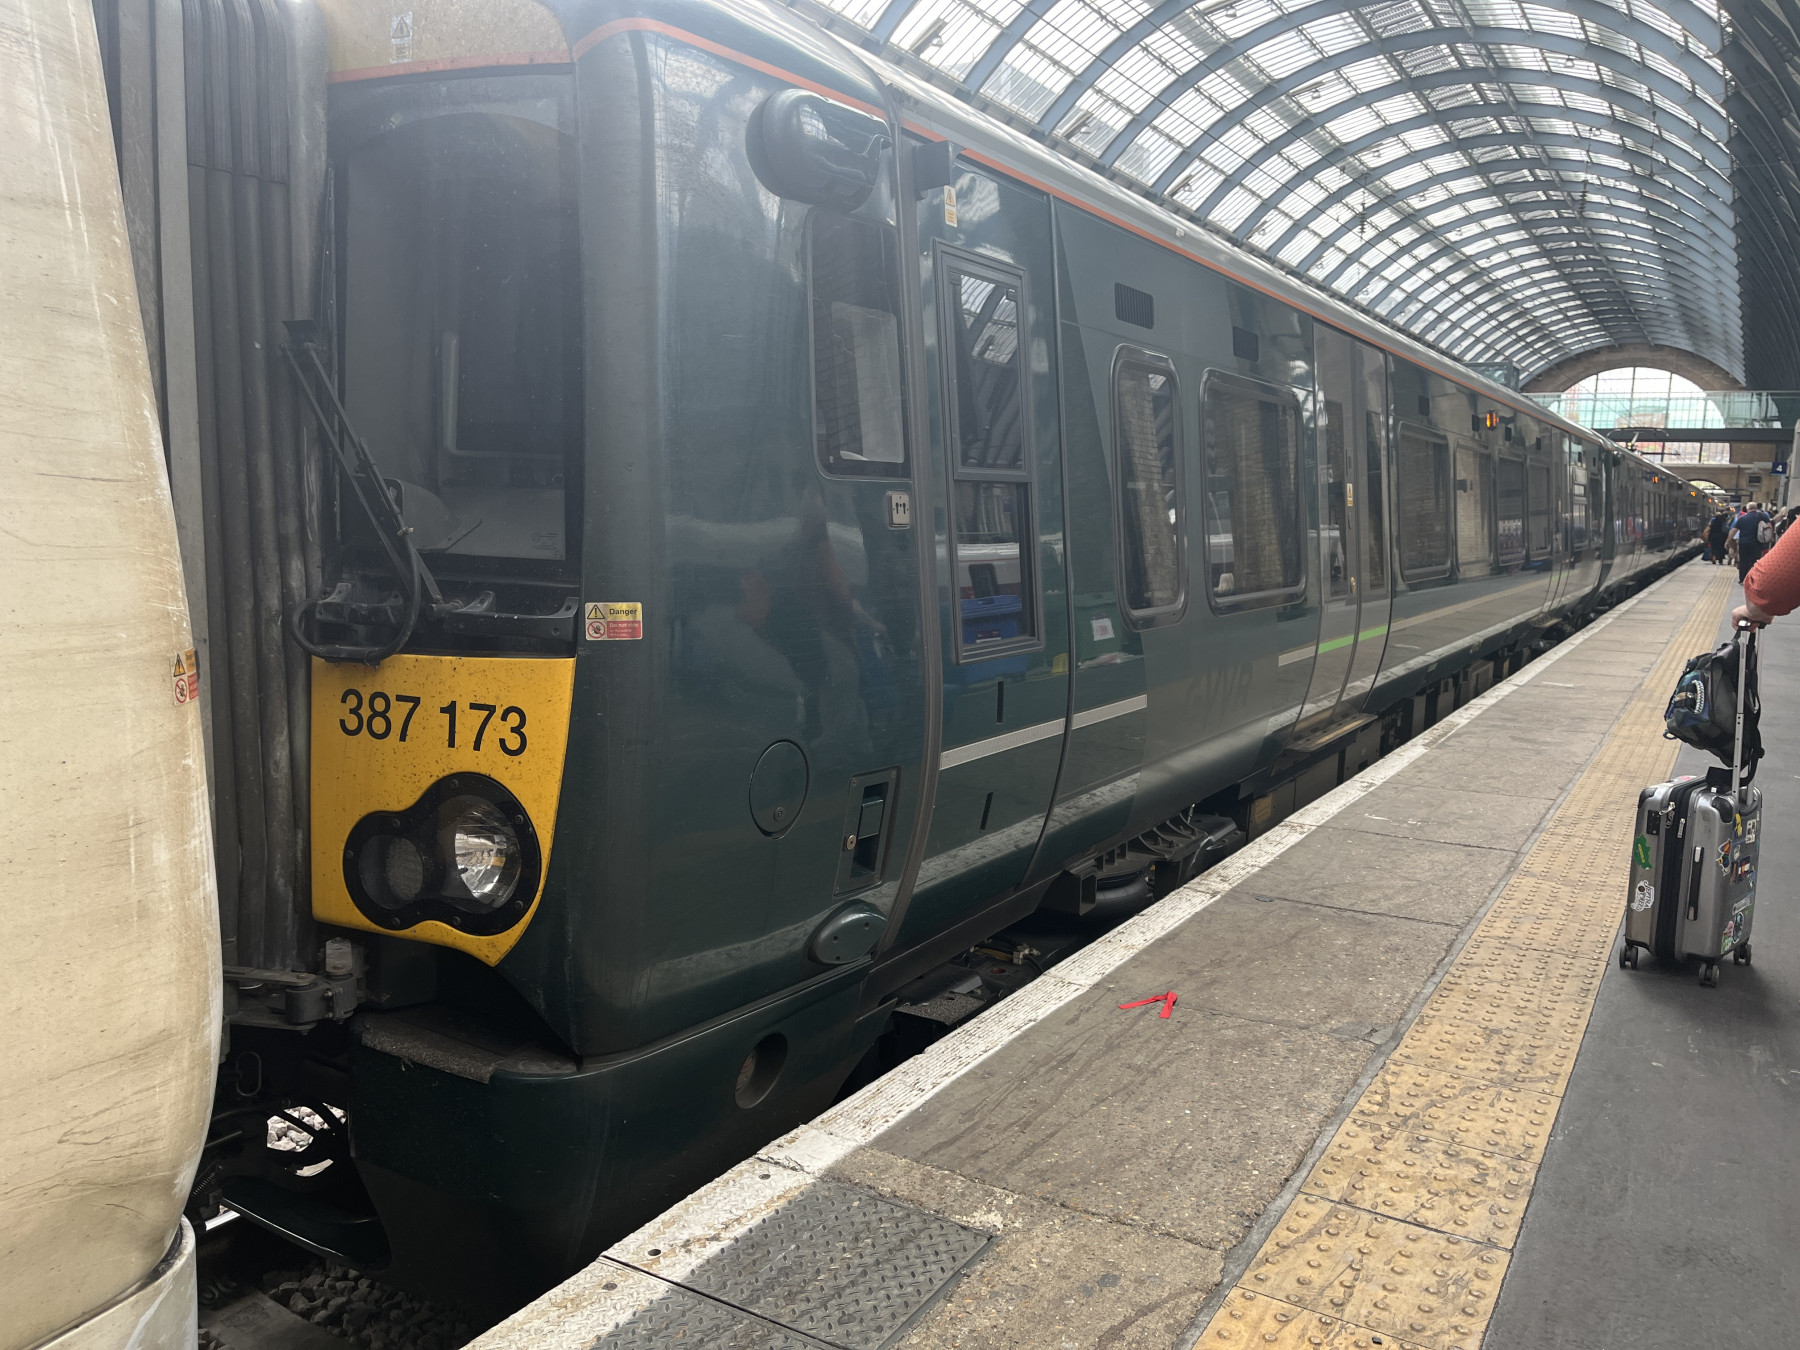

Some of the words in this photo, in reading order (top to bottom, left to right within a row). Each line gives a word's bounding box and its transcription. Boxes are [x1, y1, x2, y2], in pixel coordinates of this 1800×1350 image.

[609, 608, 638, 616] Danger
[339, 688, 421, 742] 387
[439, 700, 528, 757] 173
